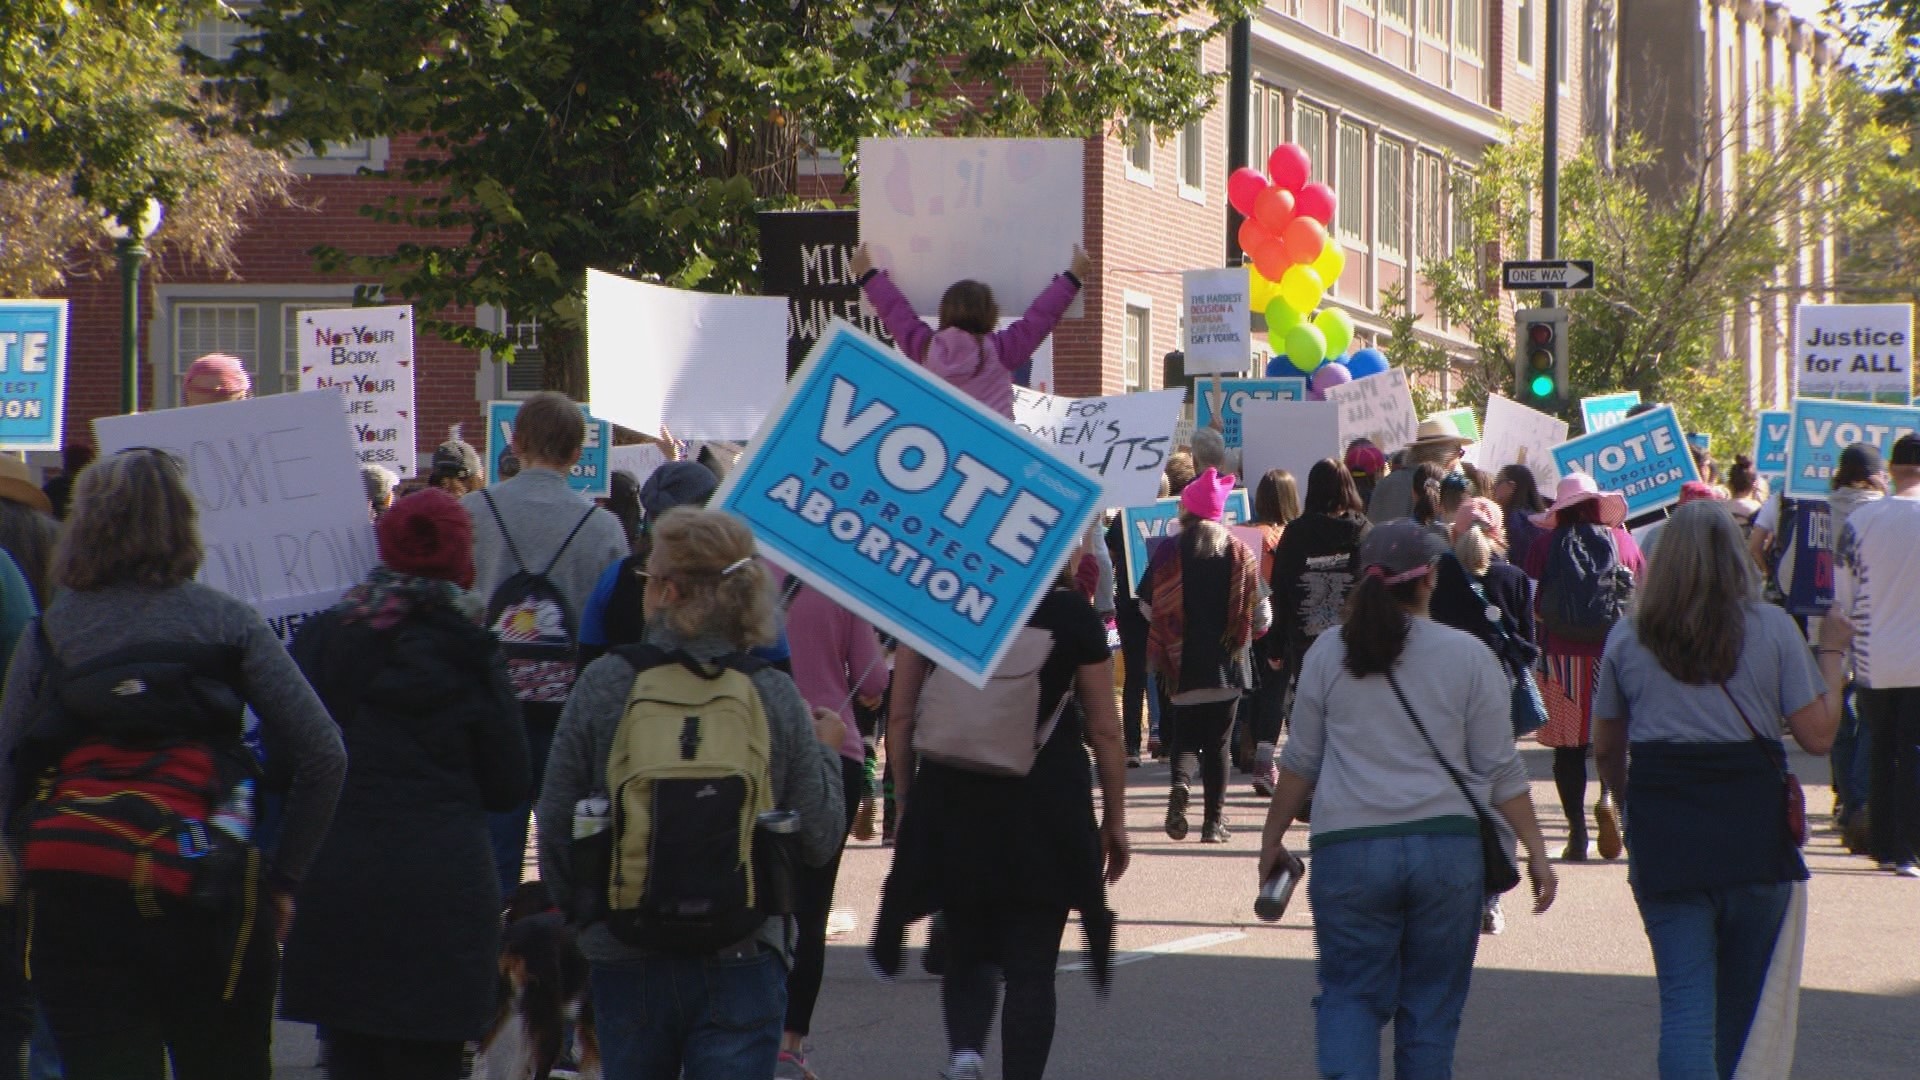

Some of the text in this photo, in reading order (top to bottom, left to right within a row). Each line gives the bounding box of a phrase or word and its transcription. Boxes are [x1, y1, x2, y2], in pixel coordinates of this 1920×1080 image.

[1512, 270, 1566, 281] ONE WAY
[1191, 295, 1206, 305] THE
[1191, 304, 1234, 315] DECISION A
[352, 325, 396, 345] YOUR
[1806, 327, 1905, 347] Justice
[1805, 353, 1903, 373] for ALL
[353, 374, 396, 394] YOUR
[346, 400, 379, 415] IFE.
[1066, 400, 1109, 418] FOR
[817, 373, 1066, 568] VOTE
[810, 457, 1006, 585] TO PROTECT
[764, 473, 998, 627] ABORTION
